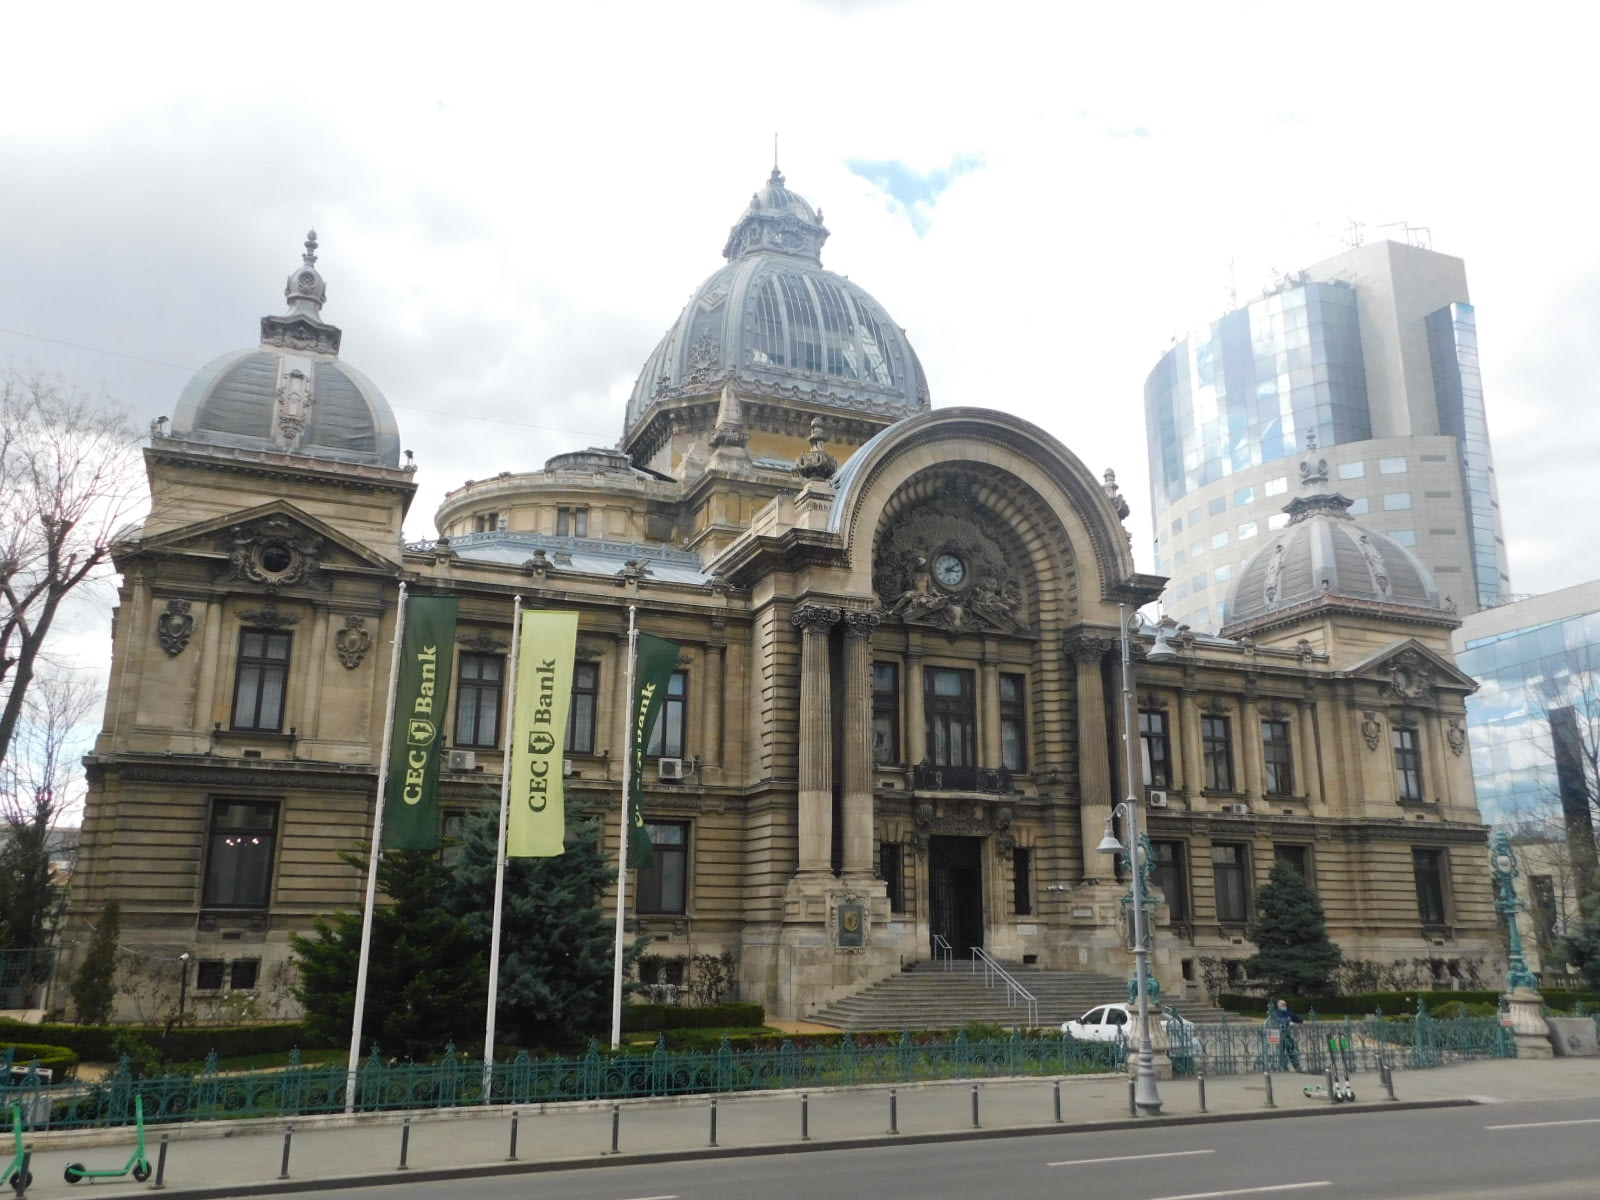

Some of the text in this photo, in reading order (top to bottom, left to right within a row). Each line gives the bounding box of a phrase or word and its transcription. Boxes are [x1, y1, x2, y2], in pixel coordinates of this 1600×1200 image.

[403, 645, 436, 805] CEC Bank
[528, 658, 556, 813] CEC Bank
